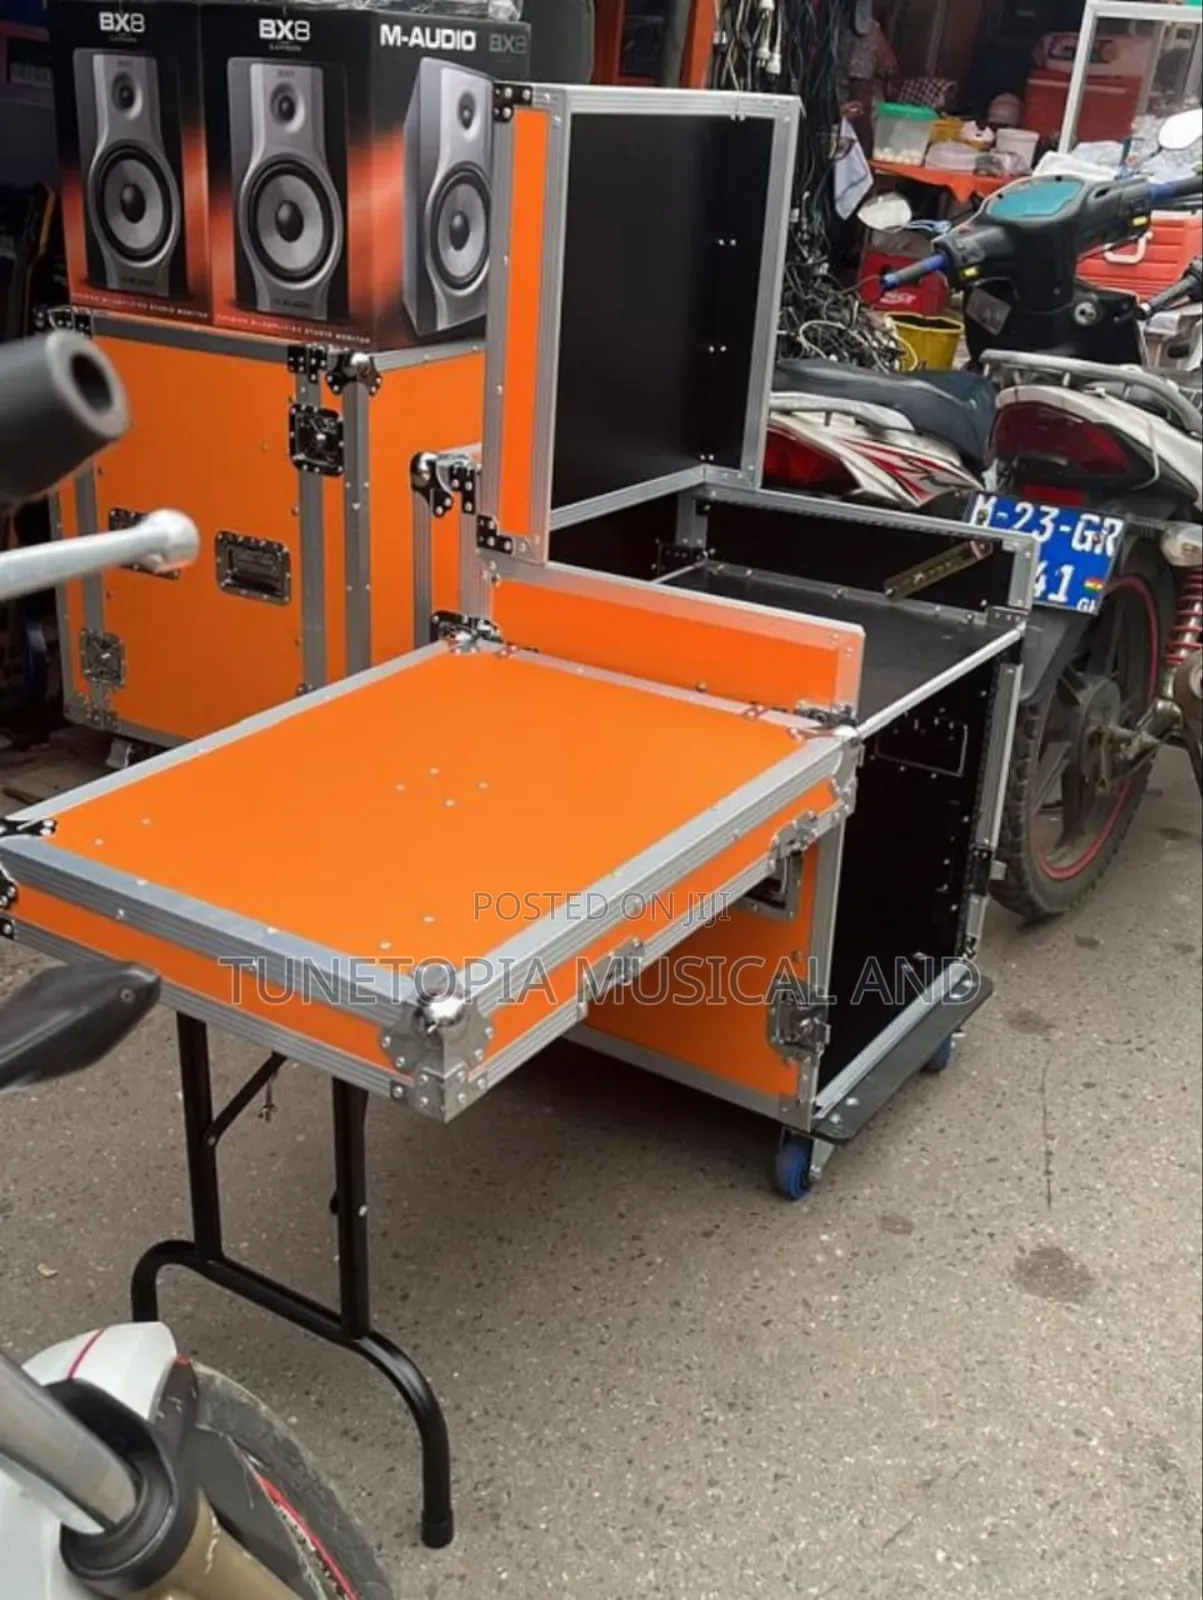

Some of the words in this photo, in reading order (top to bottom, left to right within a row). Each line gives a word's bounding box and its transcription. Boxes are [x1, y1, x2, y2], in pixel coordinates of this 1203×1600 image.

[99, 12, 146, 33] BX8
[258, 19, 310, 41] BX8
[379, 24, 477, 52] M-AUDIO
